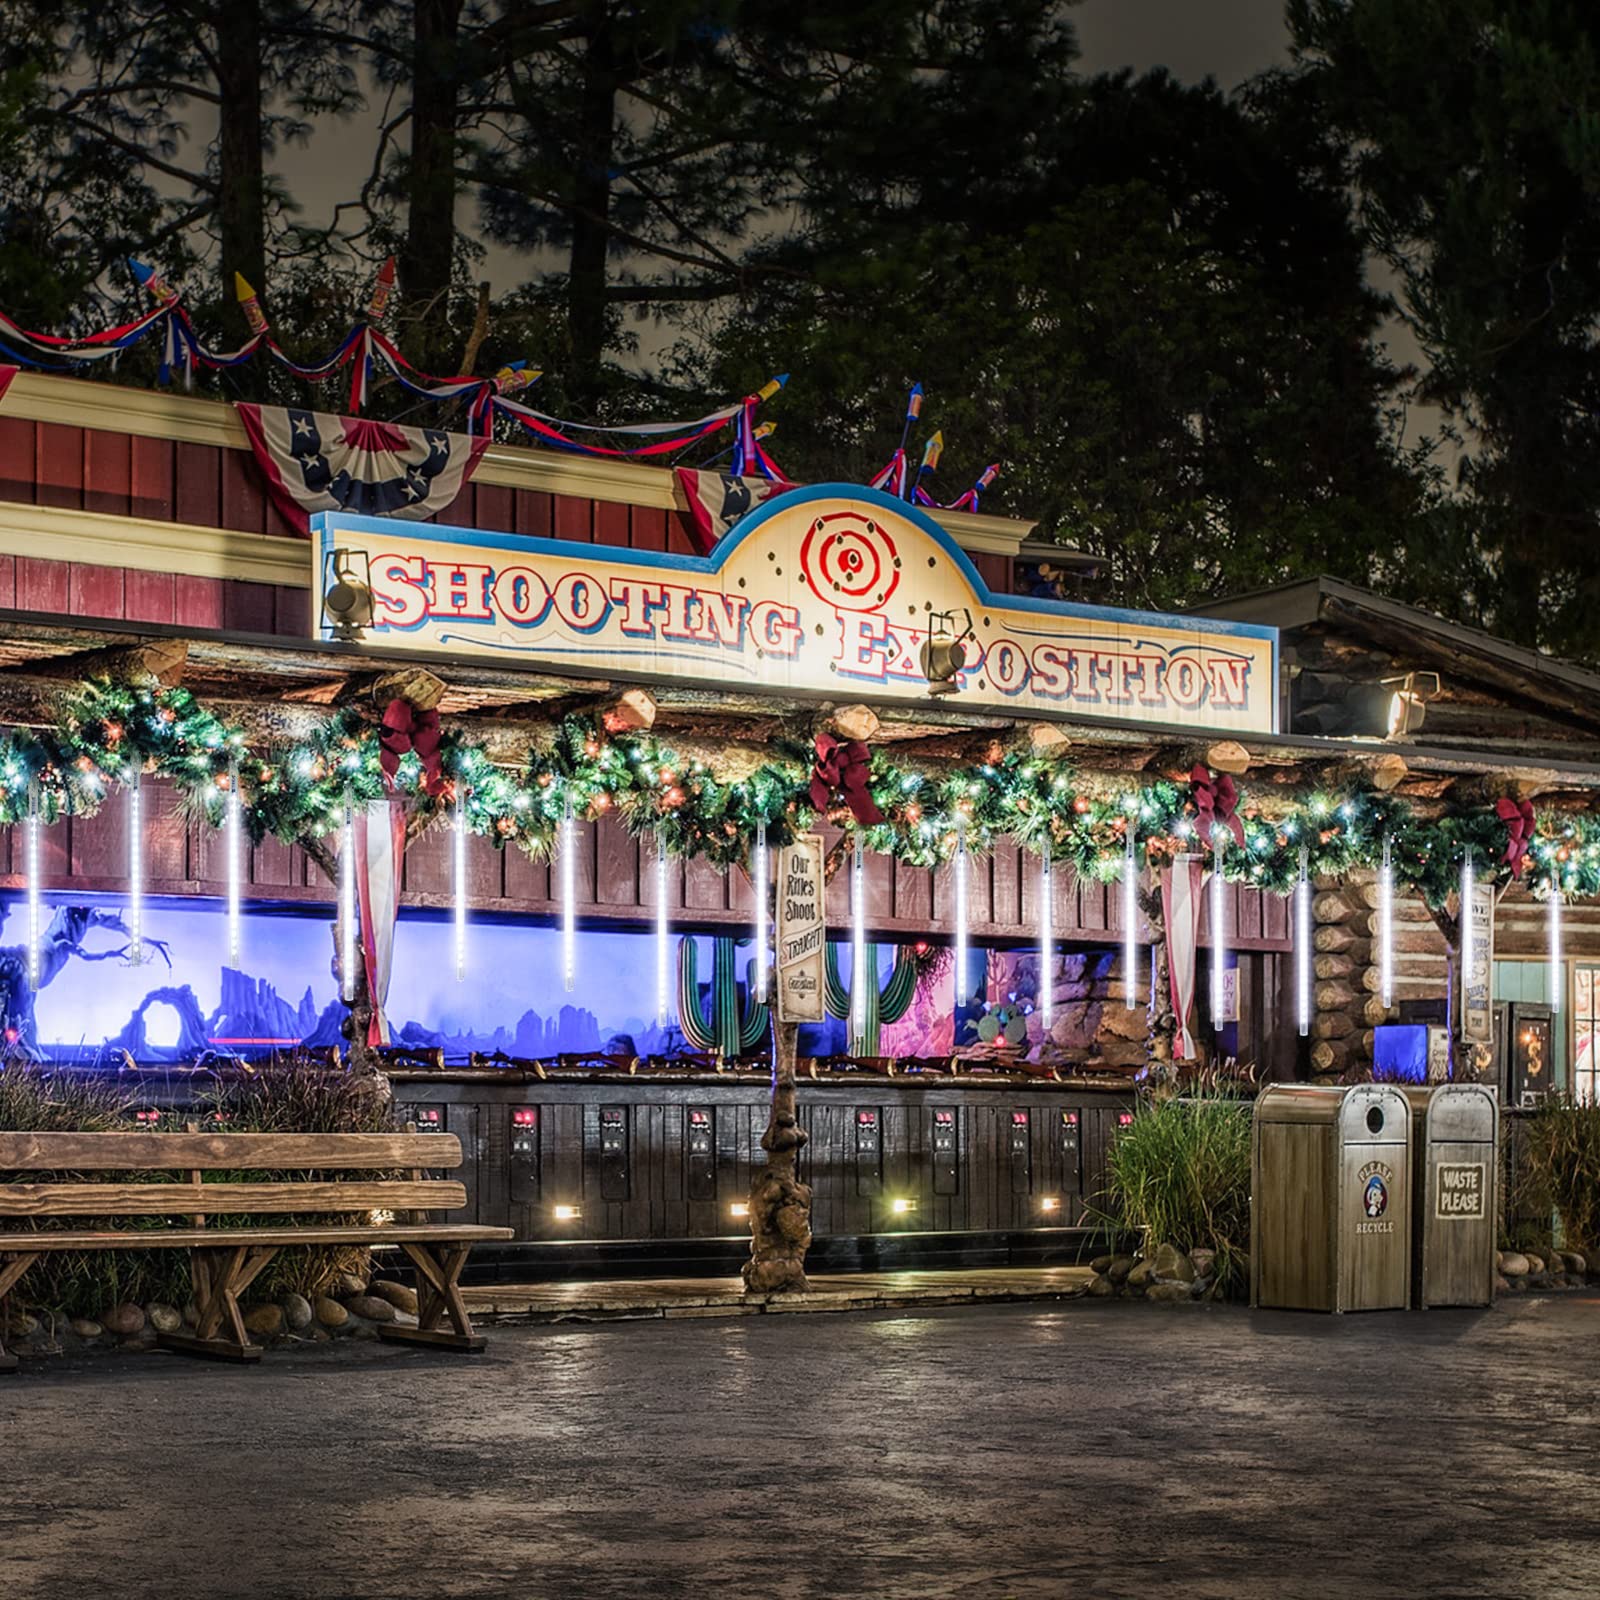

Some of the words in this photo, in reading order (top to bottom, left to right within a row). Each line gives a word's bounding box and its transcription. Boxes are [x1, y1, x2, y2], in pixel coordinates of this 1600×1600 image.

[368, 553, 804, 661] SHOOTING
[785, 898, 816, 922] Shoot
[1358, 1161, 1393, 1184] PLEASE
[1443, 1170, 1479, 1189] WASTE
[1441, 1191, 1480, 1211] PLEASE
[1356, 1221, 1394, 1234] RECYCLE
